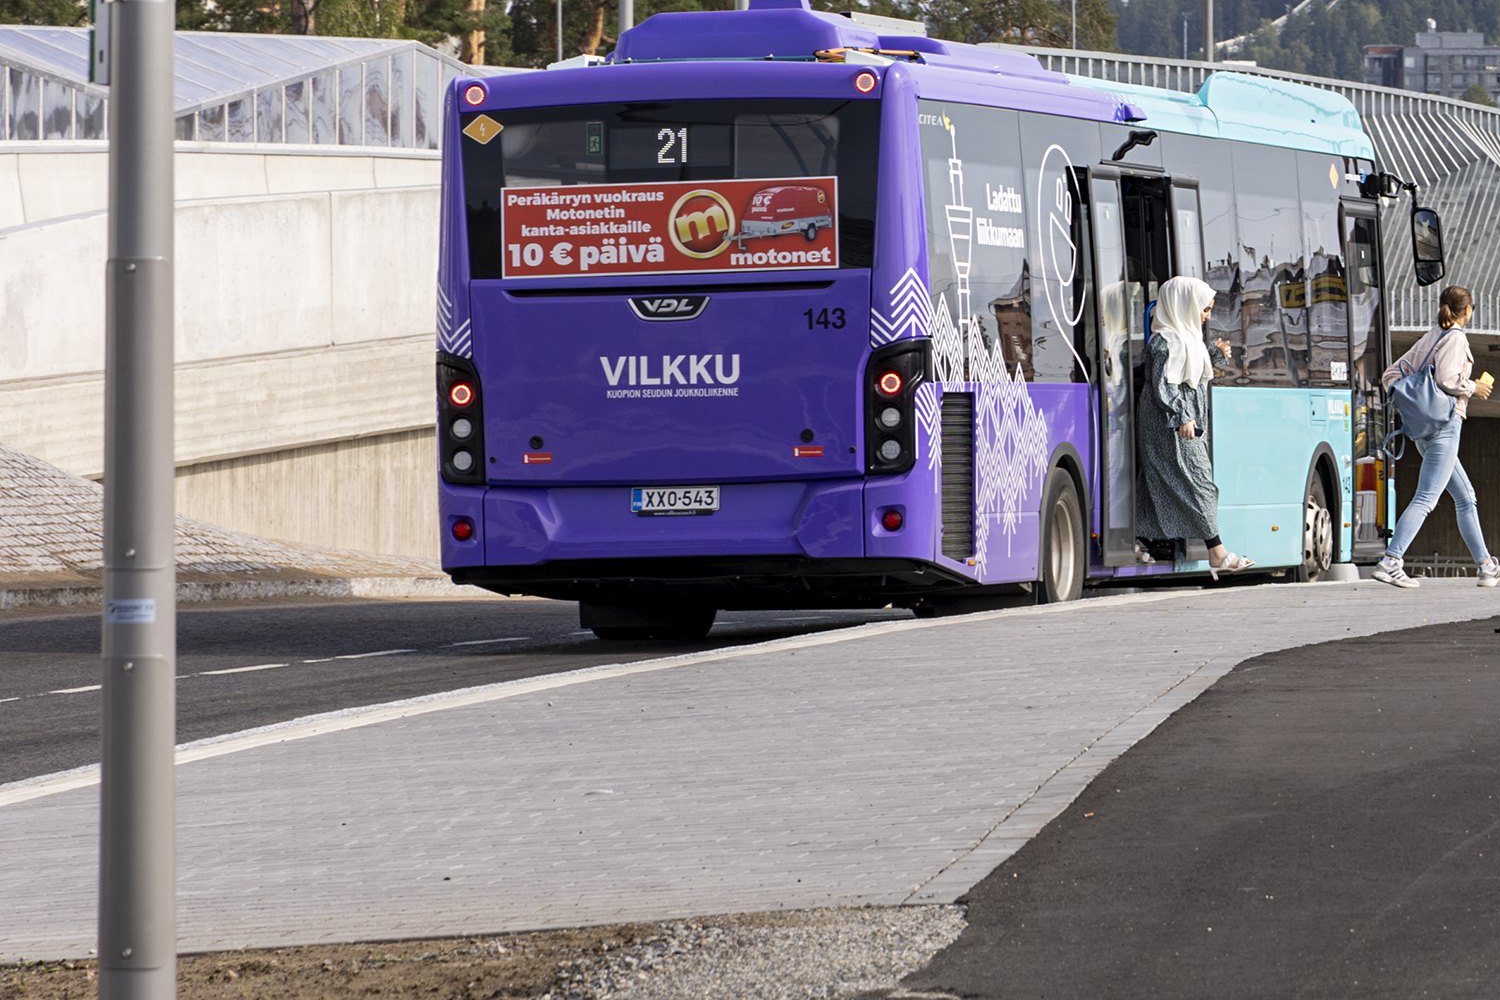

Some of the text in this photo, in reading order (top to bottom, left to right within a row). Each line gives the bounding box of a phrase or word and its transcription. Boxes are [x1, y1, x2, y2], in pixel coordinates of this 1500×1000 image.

[918, 114, 943, 126] CITEA
[656, 127, 688, 164] 21
[507, 190, 664, 208] Peräkärryn vuokraus
[986, 183, 1022, 213] Ladattu
[546, 206, 625, 221] Motonetin
[521, 221, 651, 237] kanta-asiakkaille
[976, 217, 1024, 249] liikkumaan
[508, 237, 665, 270] 10 € päivä
[730, 247, 832, 266] motonet
[642, 298, 695, 313] VDL
[803, 308, 846, 330] 143
[600, 353, 740, 386] VILKKU
[606, 387, 739, 399] KUOPION SEUDUN JOUKKOLIIKENNE
